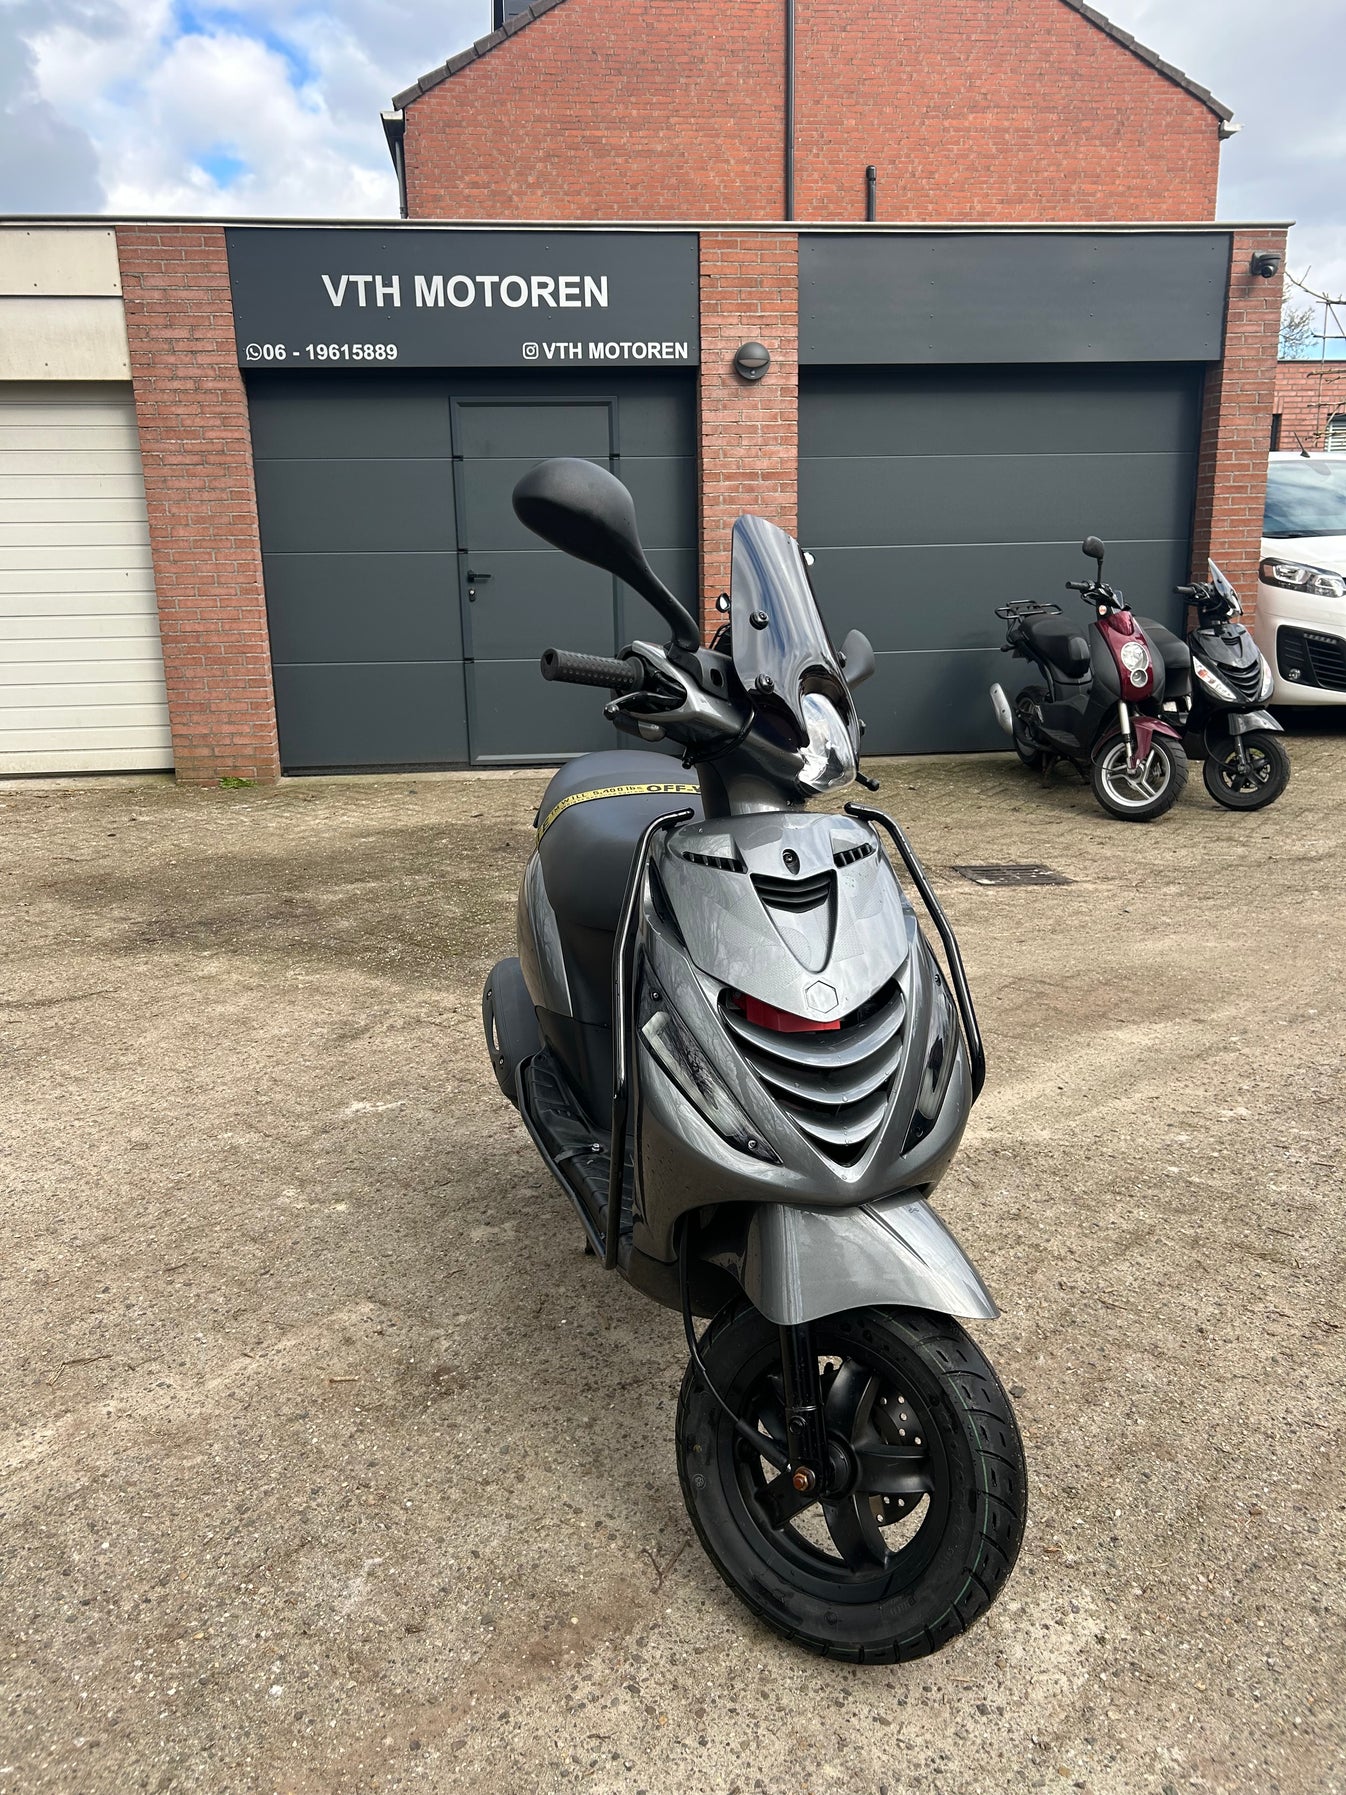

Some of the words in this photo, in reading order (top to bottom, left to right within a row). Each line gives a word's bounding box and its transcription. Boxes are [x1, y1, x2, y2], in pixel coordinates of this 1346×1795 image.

[321, 274, 401, 308] VTH
[414, 274, 609, 308] MOTOREN
[262, 343, 287, 361] 06
[305, 343, 398, 361] 19615889
[541, 342, 583, 360] VTH
[588, 341, 689, 360] MOTOREN
